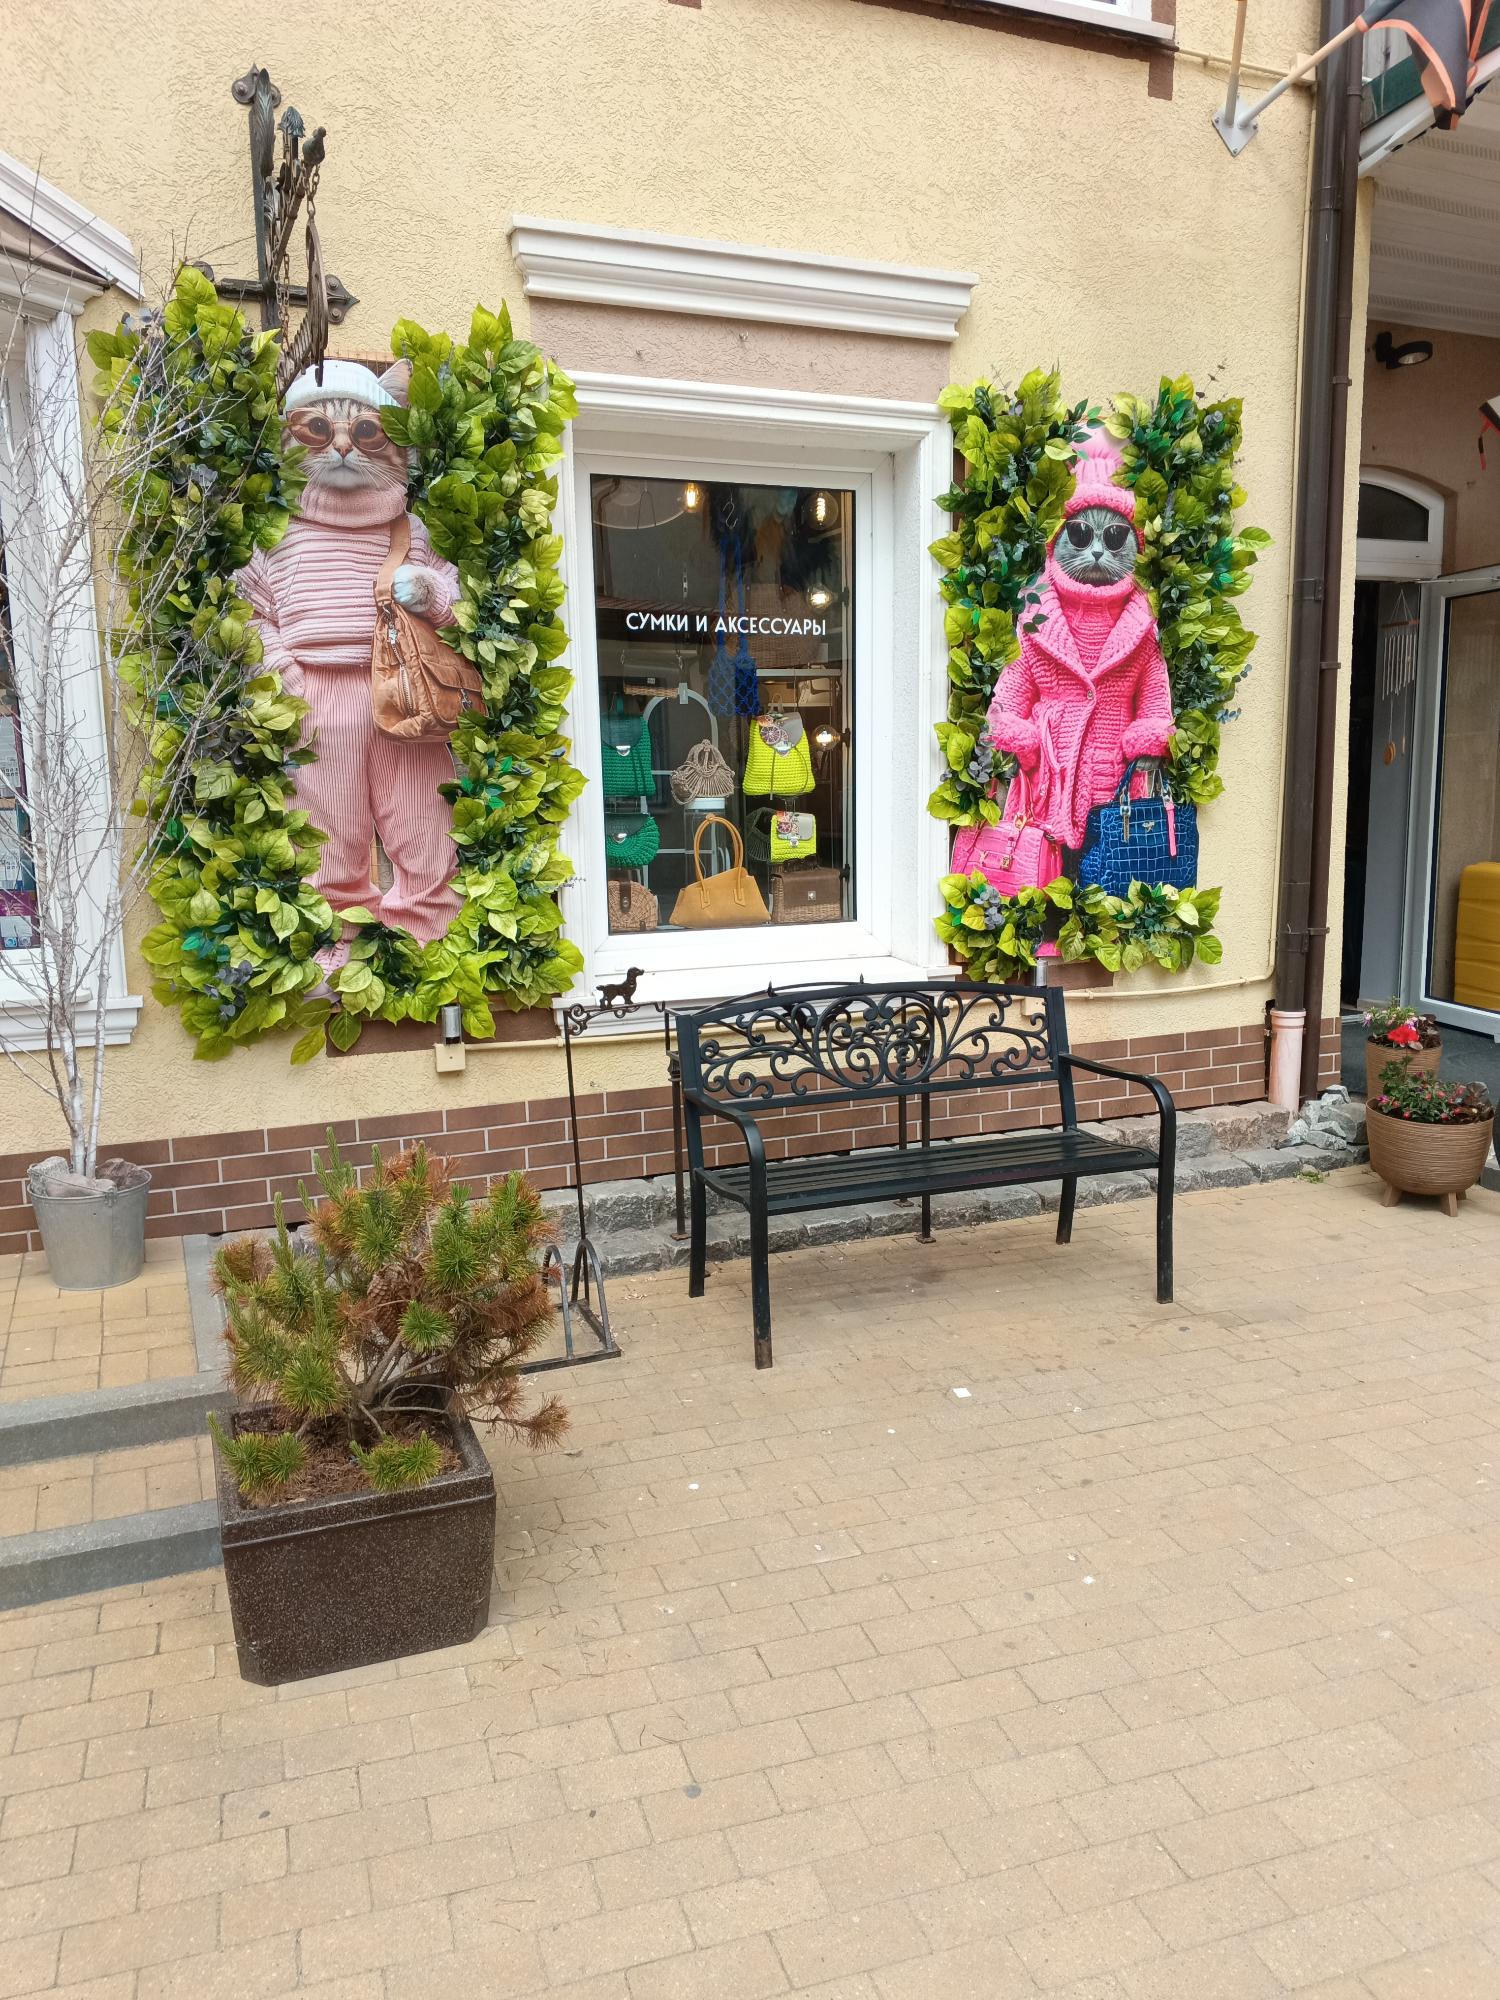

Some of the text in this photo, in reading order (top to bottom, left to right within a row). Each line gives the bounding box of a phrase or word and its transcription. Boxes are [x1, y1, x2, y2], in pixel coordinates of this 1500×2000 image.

[626, 612, 826, 636] СУМКИ И АКСЕССУАРЫ
